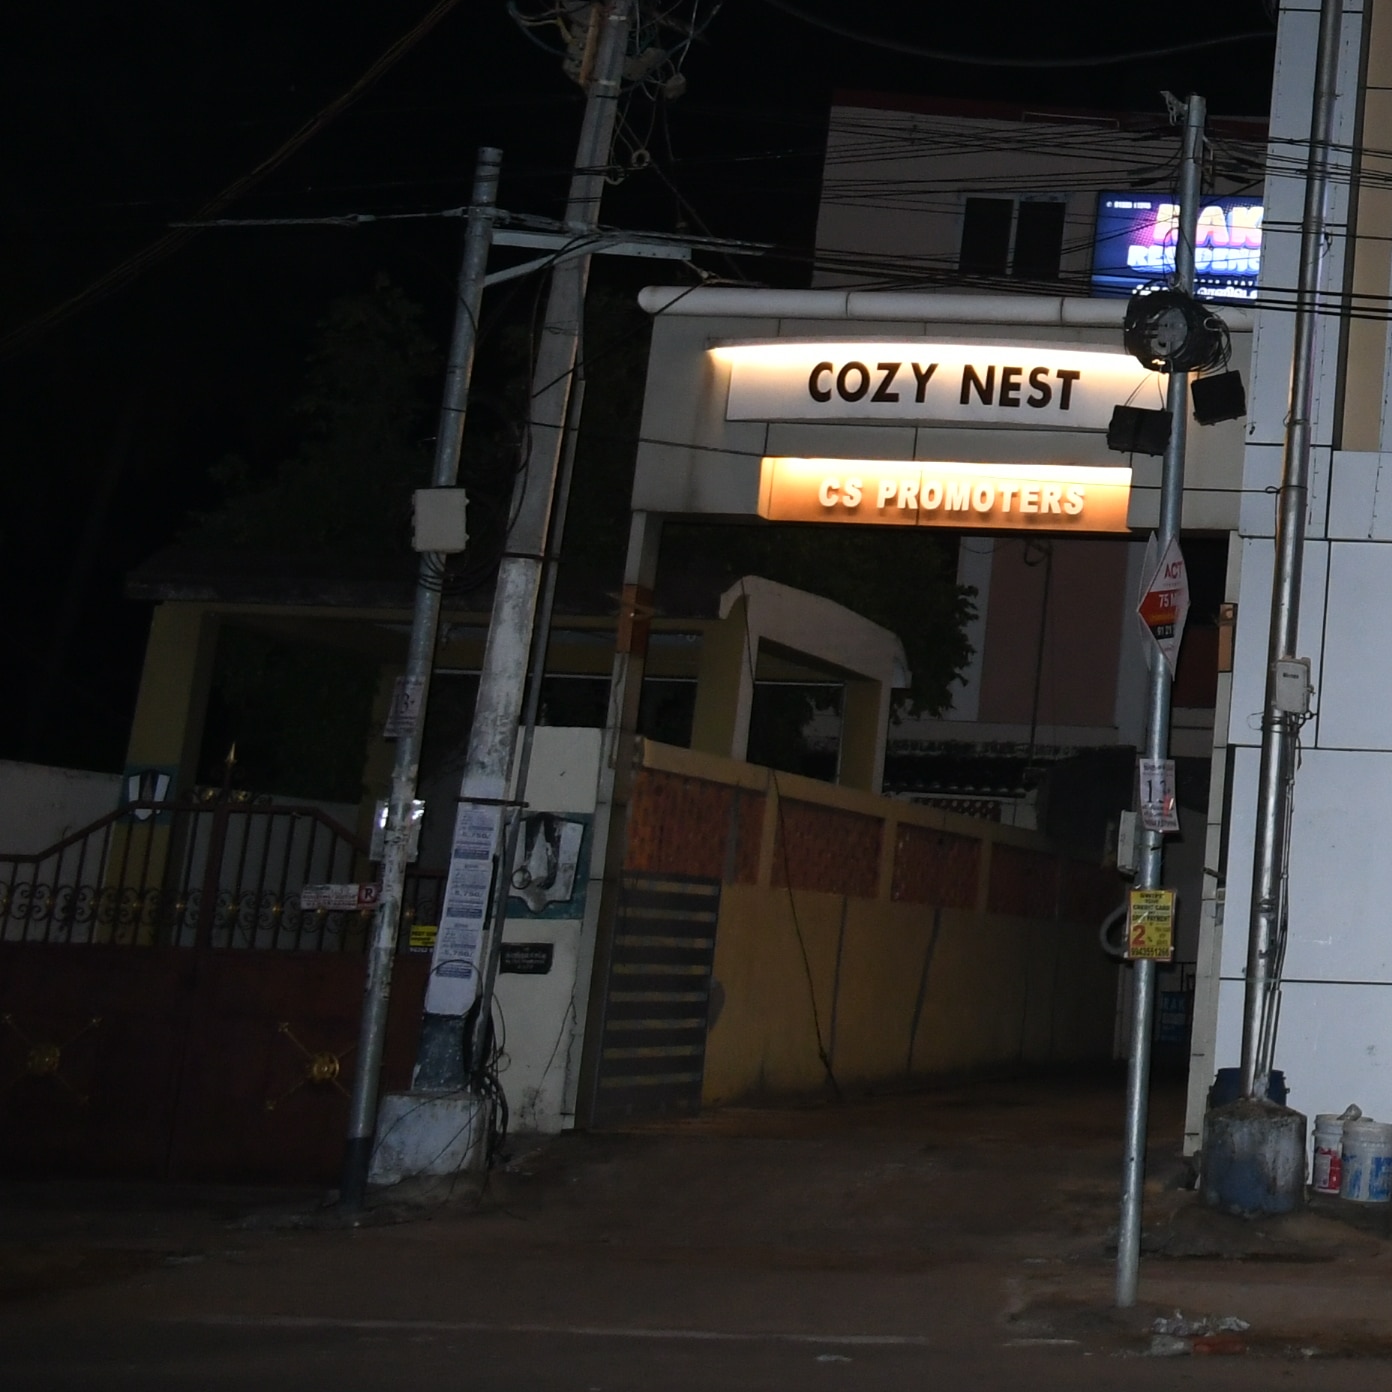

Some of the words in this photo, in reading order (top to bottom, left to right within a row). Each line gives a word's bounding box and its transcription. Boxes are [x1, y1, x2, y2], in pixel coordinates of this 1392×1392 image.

[808, 361, 939, 403] COZY
[960, 364, 1080, 410] NEST
[818, 478, 864, 508] CS
[876, 479, 1085, 515] PROMOTERS
[1164, 561, 1184, 579] ACT
